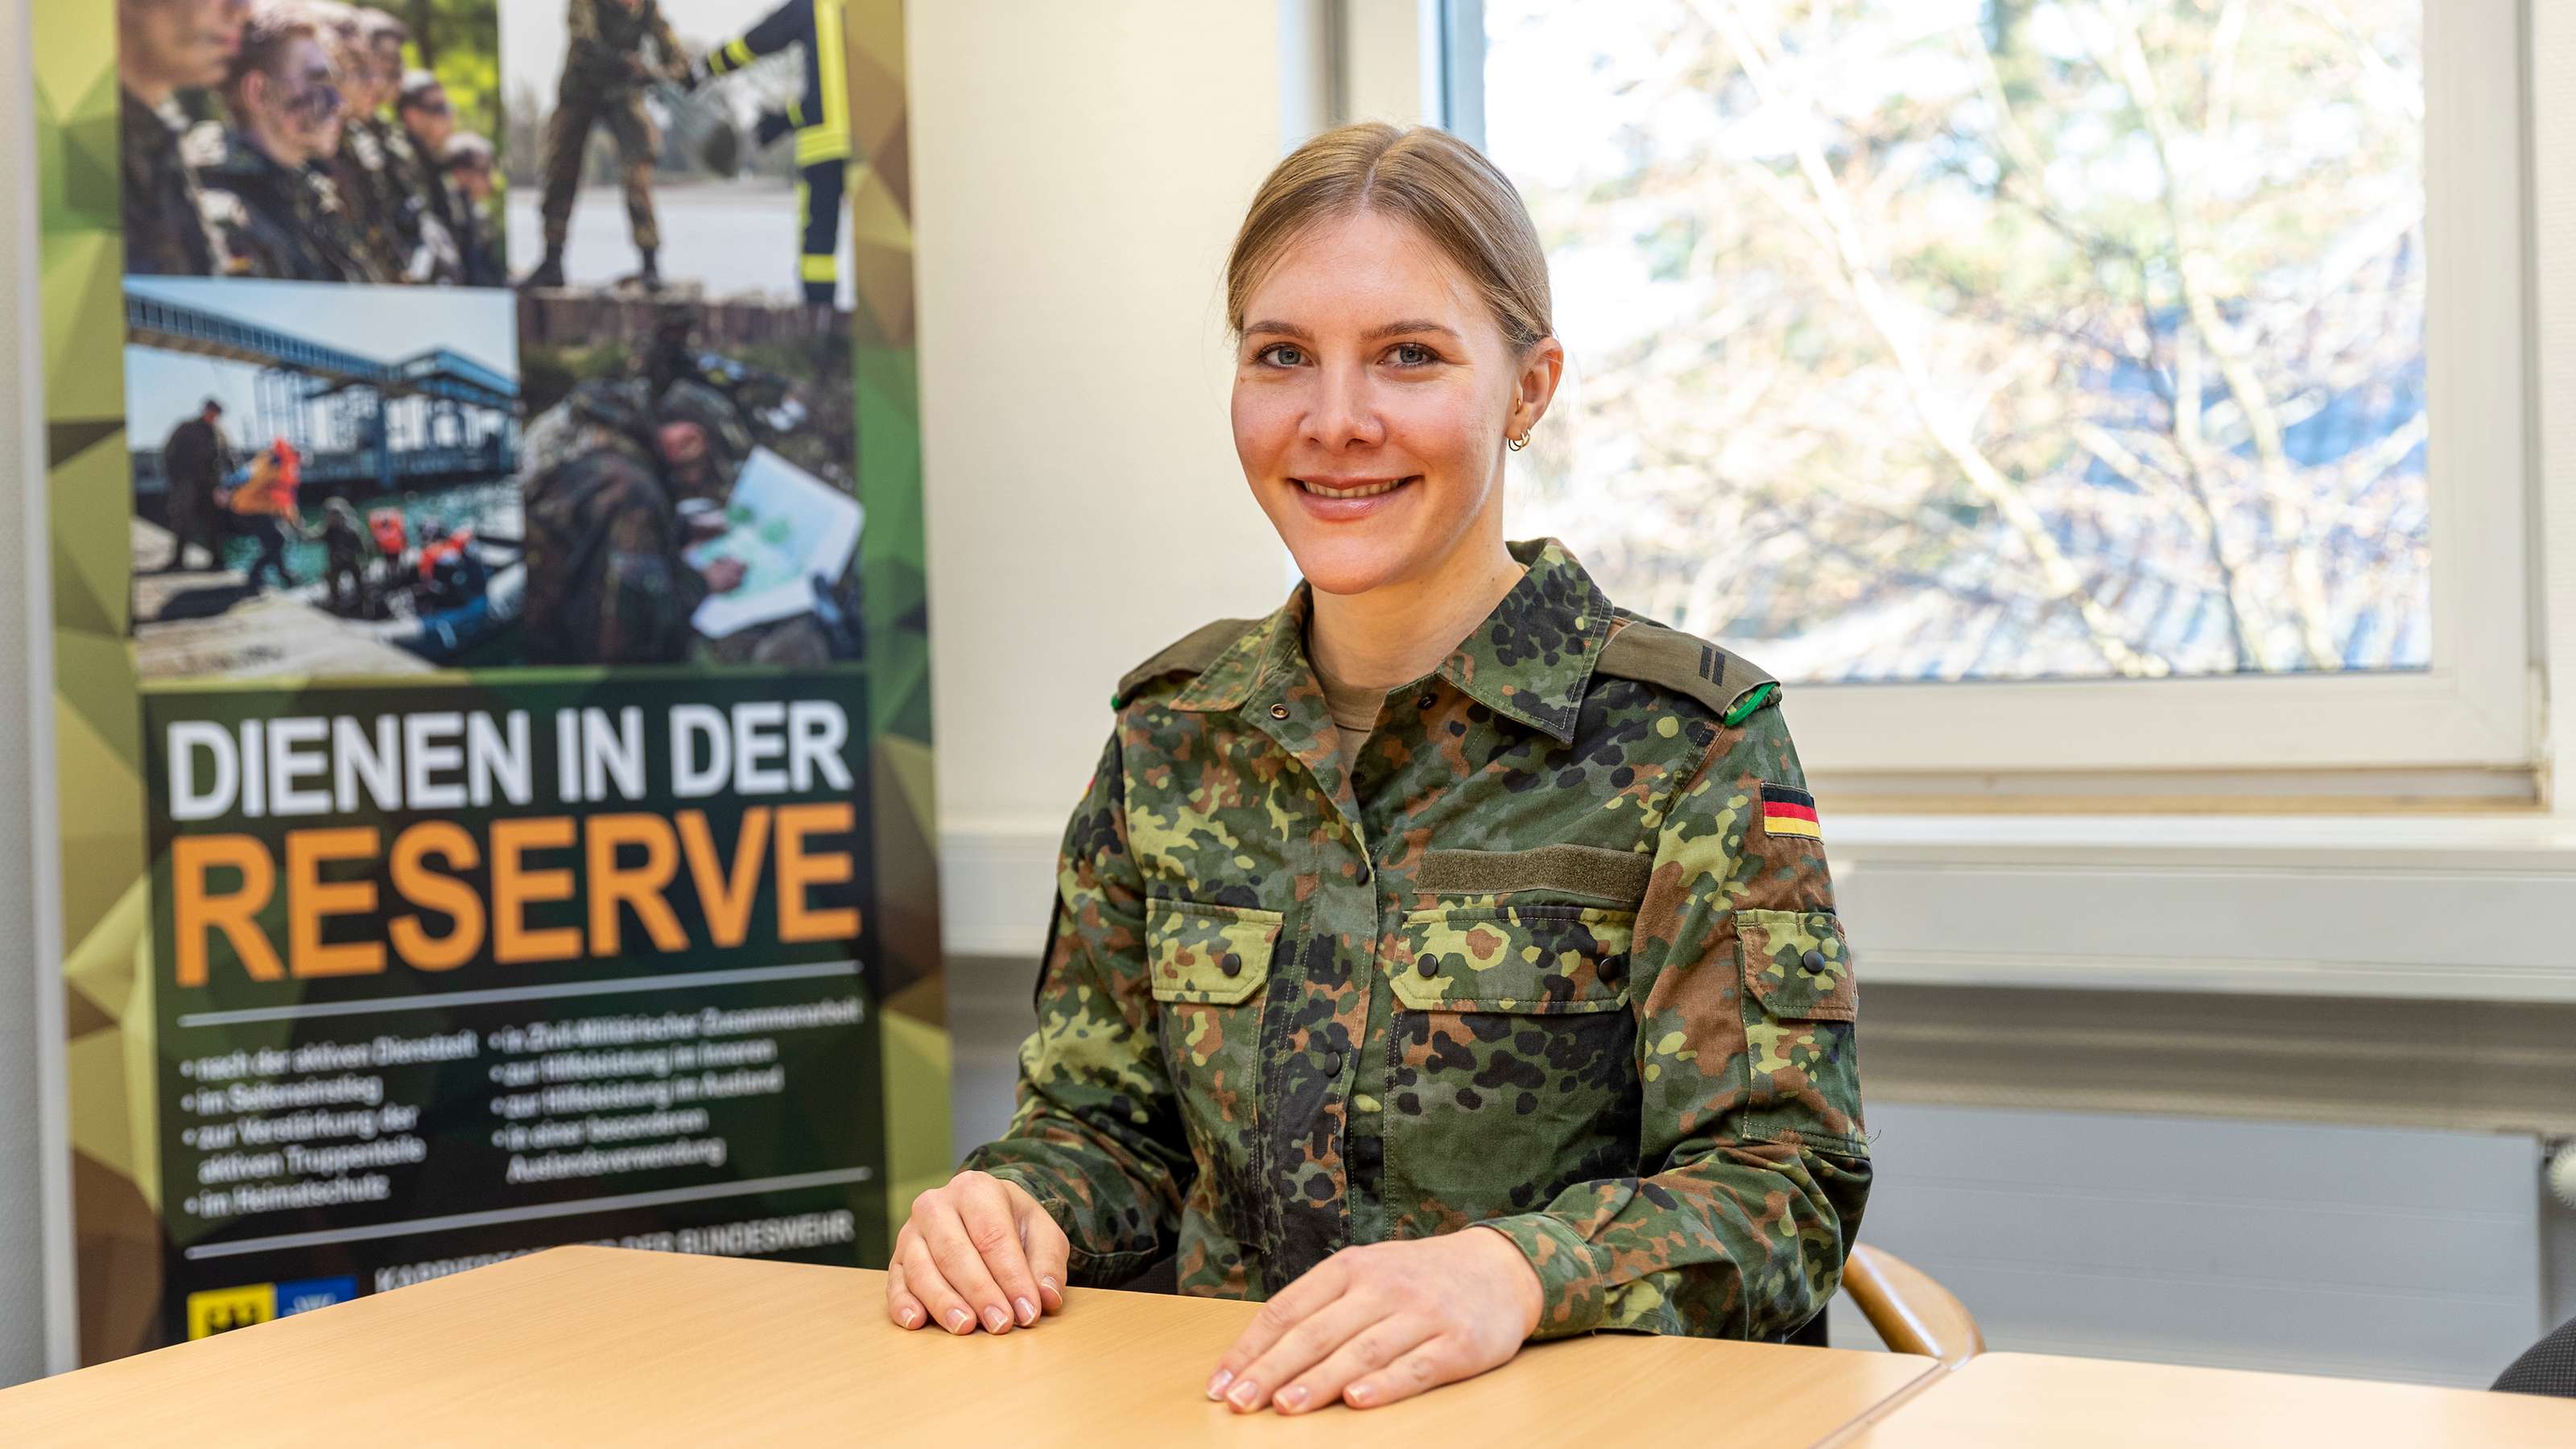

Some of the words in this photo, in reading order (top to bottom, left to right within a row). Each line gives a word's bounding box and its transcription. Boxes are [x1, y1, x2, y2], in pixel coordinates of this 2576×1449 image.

[166, 710, 533, 821] DIENEN
[555, 705, 646, 803] IN
[669, 700, 855, 798] DER
[171, 803, 862, 988] RESERVE
[502, 1025, 526, 1054] in
[699, 997, 863, 1036] Zusammenarbeit
[196, 1050, 249, 1081] nach
[251, 1047, 290, 1075] der
[291, 1041, 372, 1072] aktiven
[372, 1030, 478, 1066] Dienstzeit
[502, 1061, 539, 1087] zur
[540, 1049, 671, 1083] Hilfeleistung
[671, 1042, 697, 1069] im
[697, 1038, 777, 1067] Inneren
[196, 1087, 227, 1115] im
[228, 1074, 383, 1113] Seiteneinstieg
[503, 1093, 540, 1119] zur
[541, 1082, 671, 1114] Hilfeleistung
[671, 1075, 698, 1100] im
[698, 1064, 784, 1098] Ausland
[197, 1122, 237, 1150] zur
[237, 1108, 378, 1145] Verstärkung
[378, 1102, 419, 1132] der
[505, 1123, 530, 1151] in
[529, 1118, 584, 1148] einer
[585, 1107, 709, 1143] besonderen
[199, 1151, 284, 1184] aktiven
[284, 1134, 427, 1176] Truppenteile
[506, 1137, 726, 1184] Auslandsverwendung
[200, 1189, 233, 1219] im
[233, 1173, 390, 1214] Heimatschutz
[676, 1209, 855, 1255] BUNDESWEHR
